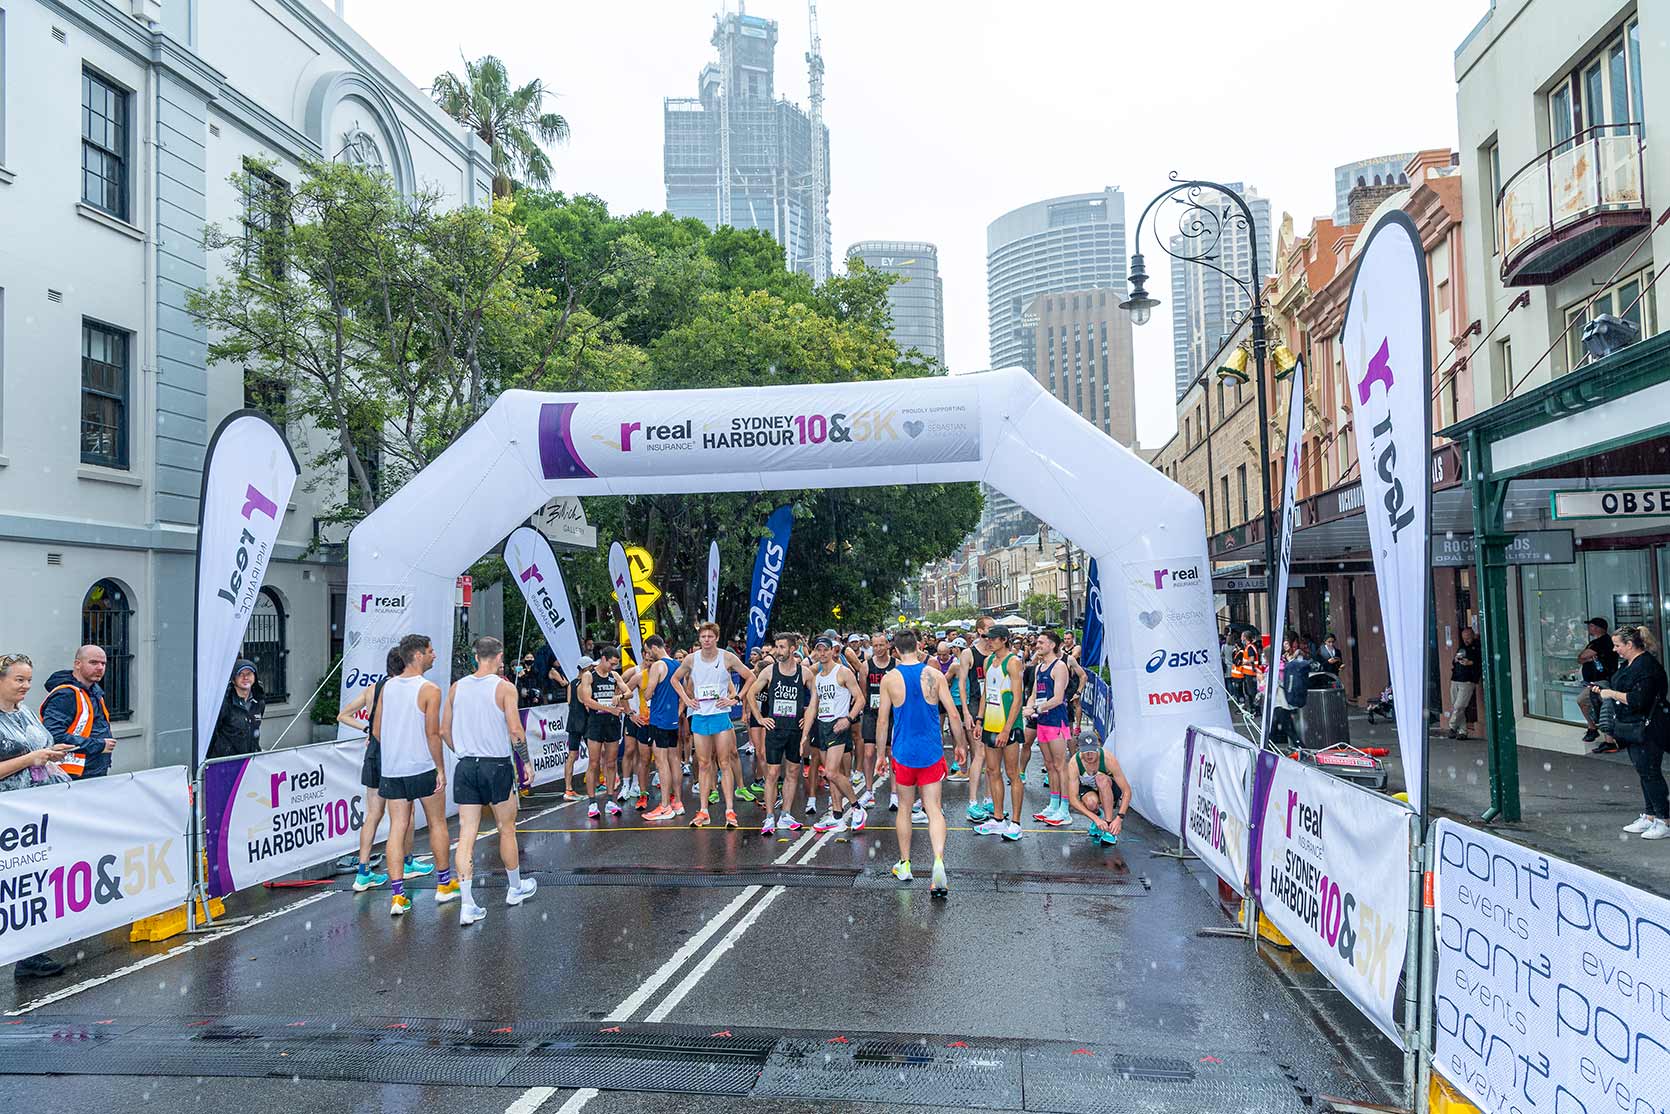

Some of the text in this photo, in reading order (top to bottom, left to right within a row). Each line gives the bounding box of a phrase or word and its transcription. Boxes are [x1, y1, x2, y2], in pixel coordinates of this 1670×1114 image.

[881, 257, 895, 266] EY
[929, 405, 966, 413] SUPPORTING
[646, 420, 692, 441] real
[731, 415, 794, 431] SYDNEY
[927, 423, 967, 432] SEBASTIAN
[703, 430, 794, 449] HARBOUR
[1373, 409, 1416, 544] real
[1601, 490, 1670, 515] OBSE
[1435, 554, 1463, 562] OPAL
[757, 540, 784, 609] asics
[1172, 566, 1199, 581] real
[375, 595, 405, 607] real
[536, 586, 566, 629] real
[639, 623, 647, 635] 5
[1168, 649, 1209, 668] asics
[774, 690, 798, 700] crew
[782, 685, 798, 694] run
[819, 692, 836, 700] rew
[821, 684, 835, 693] run
[1148, 686, 1214, 705] nova 96.9
[549, 716, 564, 731] real
[543, 741, 567, 755] SYDNEY
[290, 764, 324, 792] real
[273, 803, 325, 832] SYDNEY
[1299, 804, 1324, 840] real
[248, 795, 364, 863] HARBOUR 10&
[1286, 848, 1322, 896] SYDNEY
[1270, 865, 1320, 933] HARBOUR
[1458, 885, 1529, 940] events
[1455, 969, 1527, 1035] events
[1580, 1056, 1660, 1114] even
